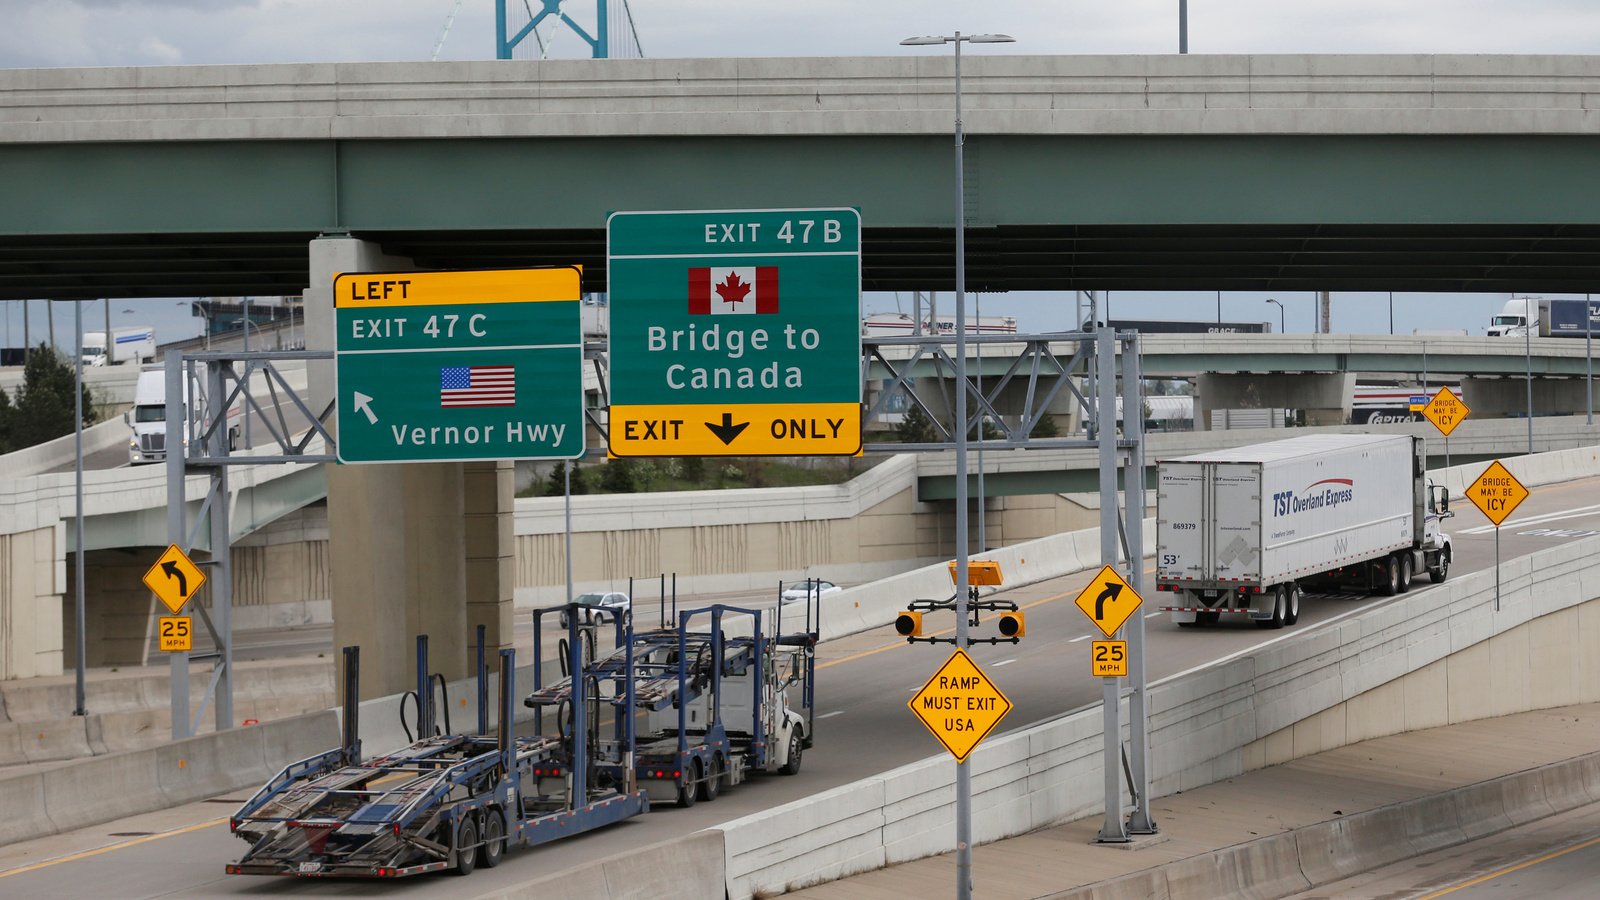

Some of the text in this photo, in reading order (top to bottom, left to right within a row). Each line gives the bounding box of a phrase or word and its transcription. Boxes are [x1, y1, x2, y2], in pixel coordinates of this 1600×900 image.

[704, 223, 761, 243] EXIT
[351, 280, 411, 300] LEFT
[352, 318, 407, 338] EXIT
[648, 323, 820, 359] Bridge to
[666, 361, 803, 389] Canada
[1438, 415, 1453, 425] ICY
[391, 421, 566, 448] Vernor Hwy
[625, 418, 845, 440] EXIT ONLY
[1482, 477, 1511, 486] BRIDGE
[1480, 488, 1513, 497] MAY BE
[1273, 488, 1353, 517] TST Overland Express
[1487, 498, 1506, 511] ICY
[162, 621, 188, 637] 25
[1095, 645, 1124, 662] 25
[1099, 664, 1120, 672] MPH
[939, 676, 980, 690] RAMP
[923, 696, 996, 711] MUST EXIT
[945, 718, 975, 731] USA
